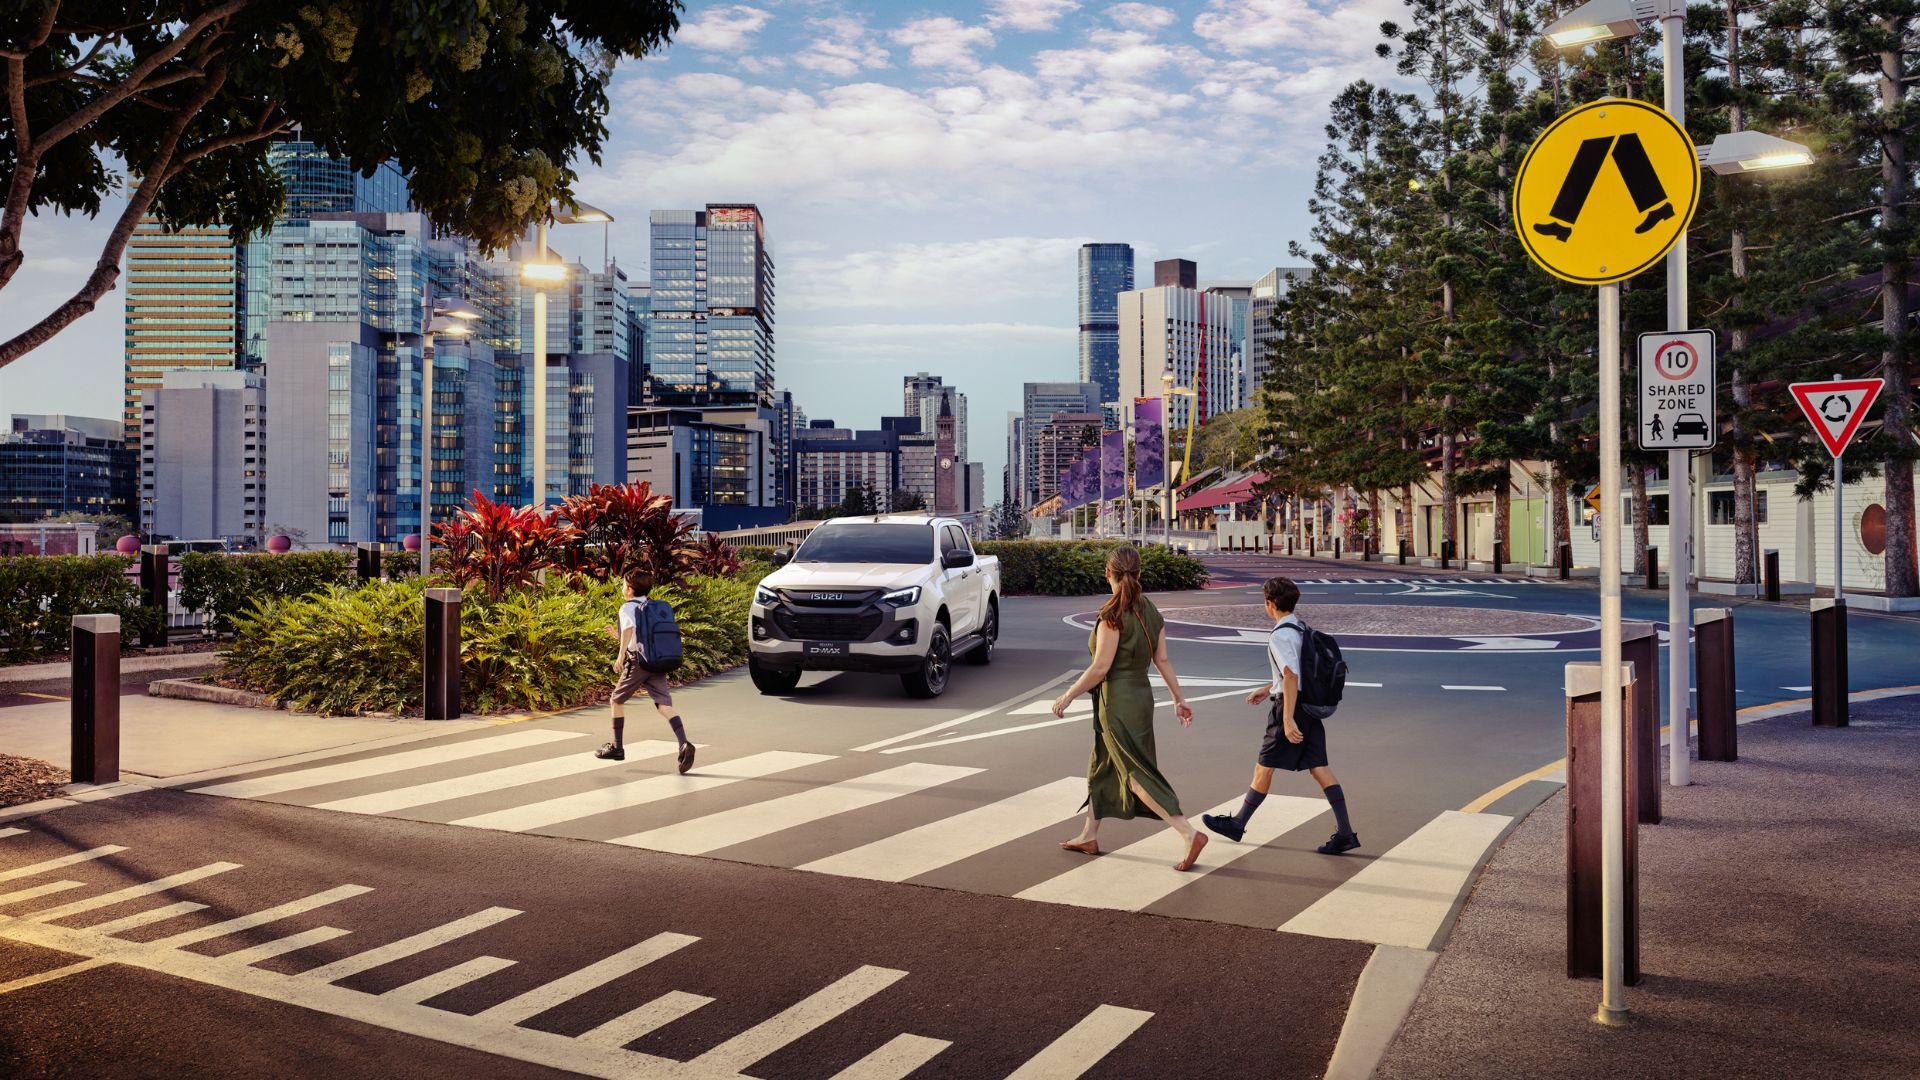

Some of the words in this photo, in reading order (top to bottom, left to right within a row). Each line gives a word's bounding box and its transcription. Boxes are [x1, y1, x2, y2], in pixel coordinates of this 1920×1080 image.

[1667, 351, 1689, 369] 10
[1648, 384, 1706, 396] SHARED
[1657, 398, 1696, 410] ZONE
